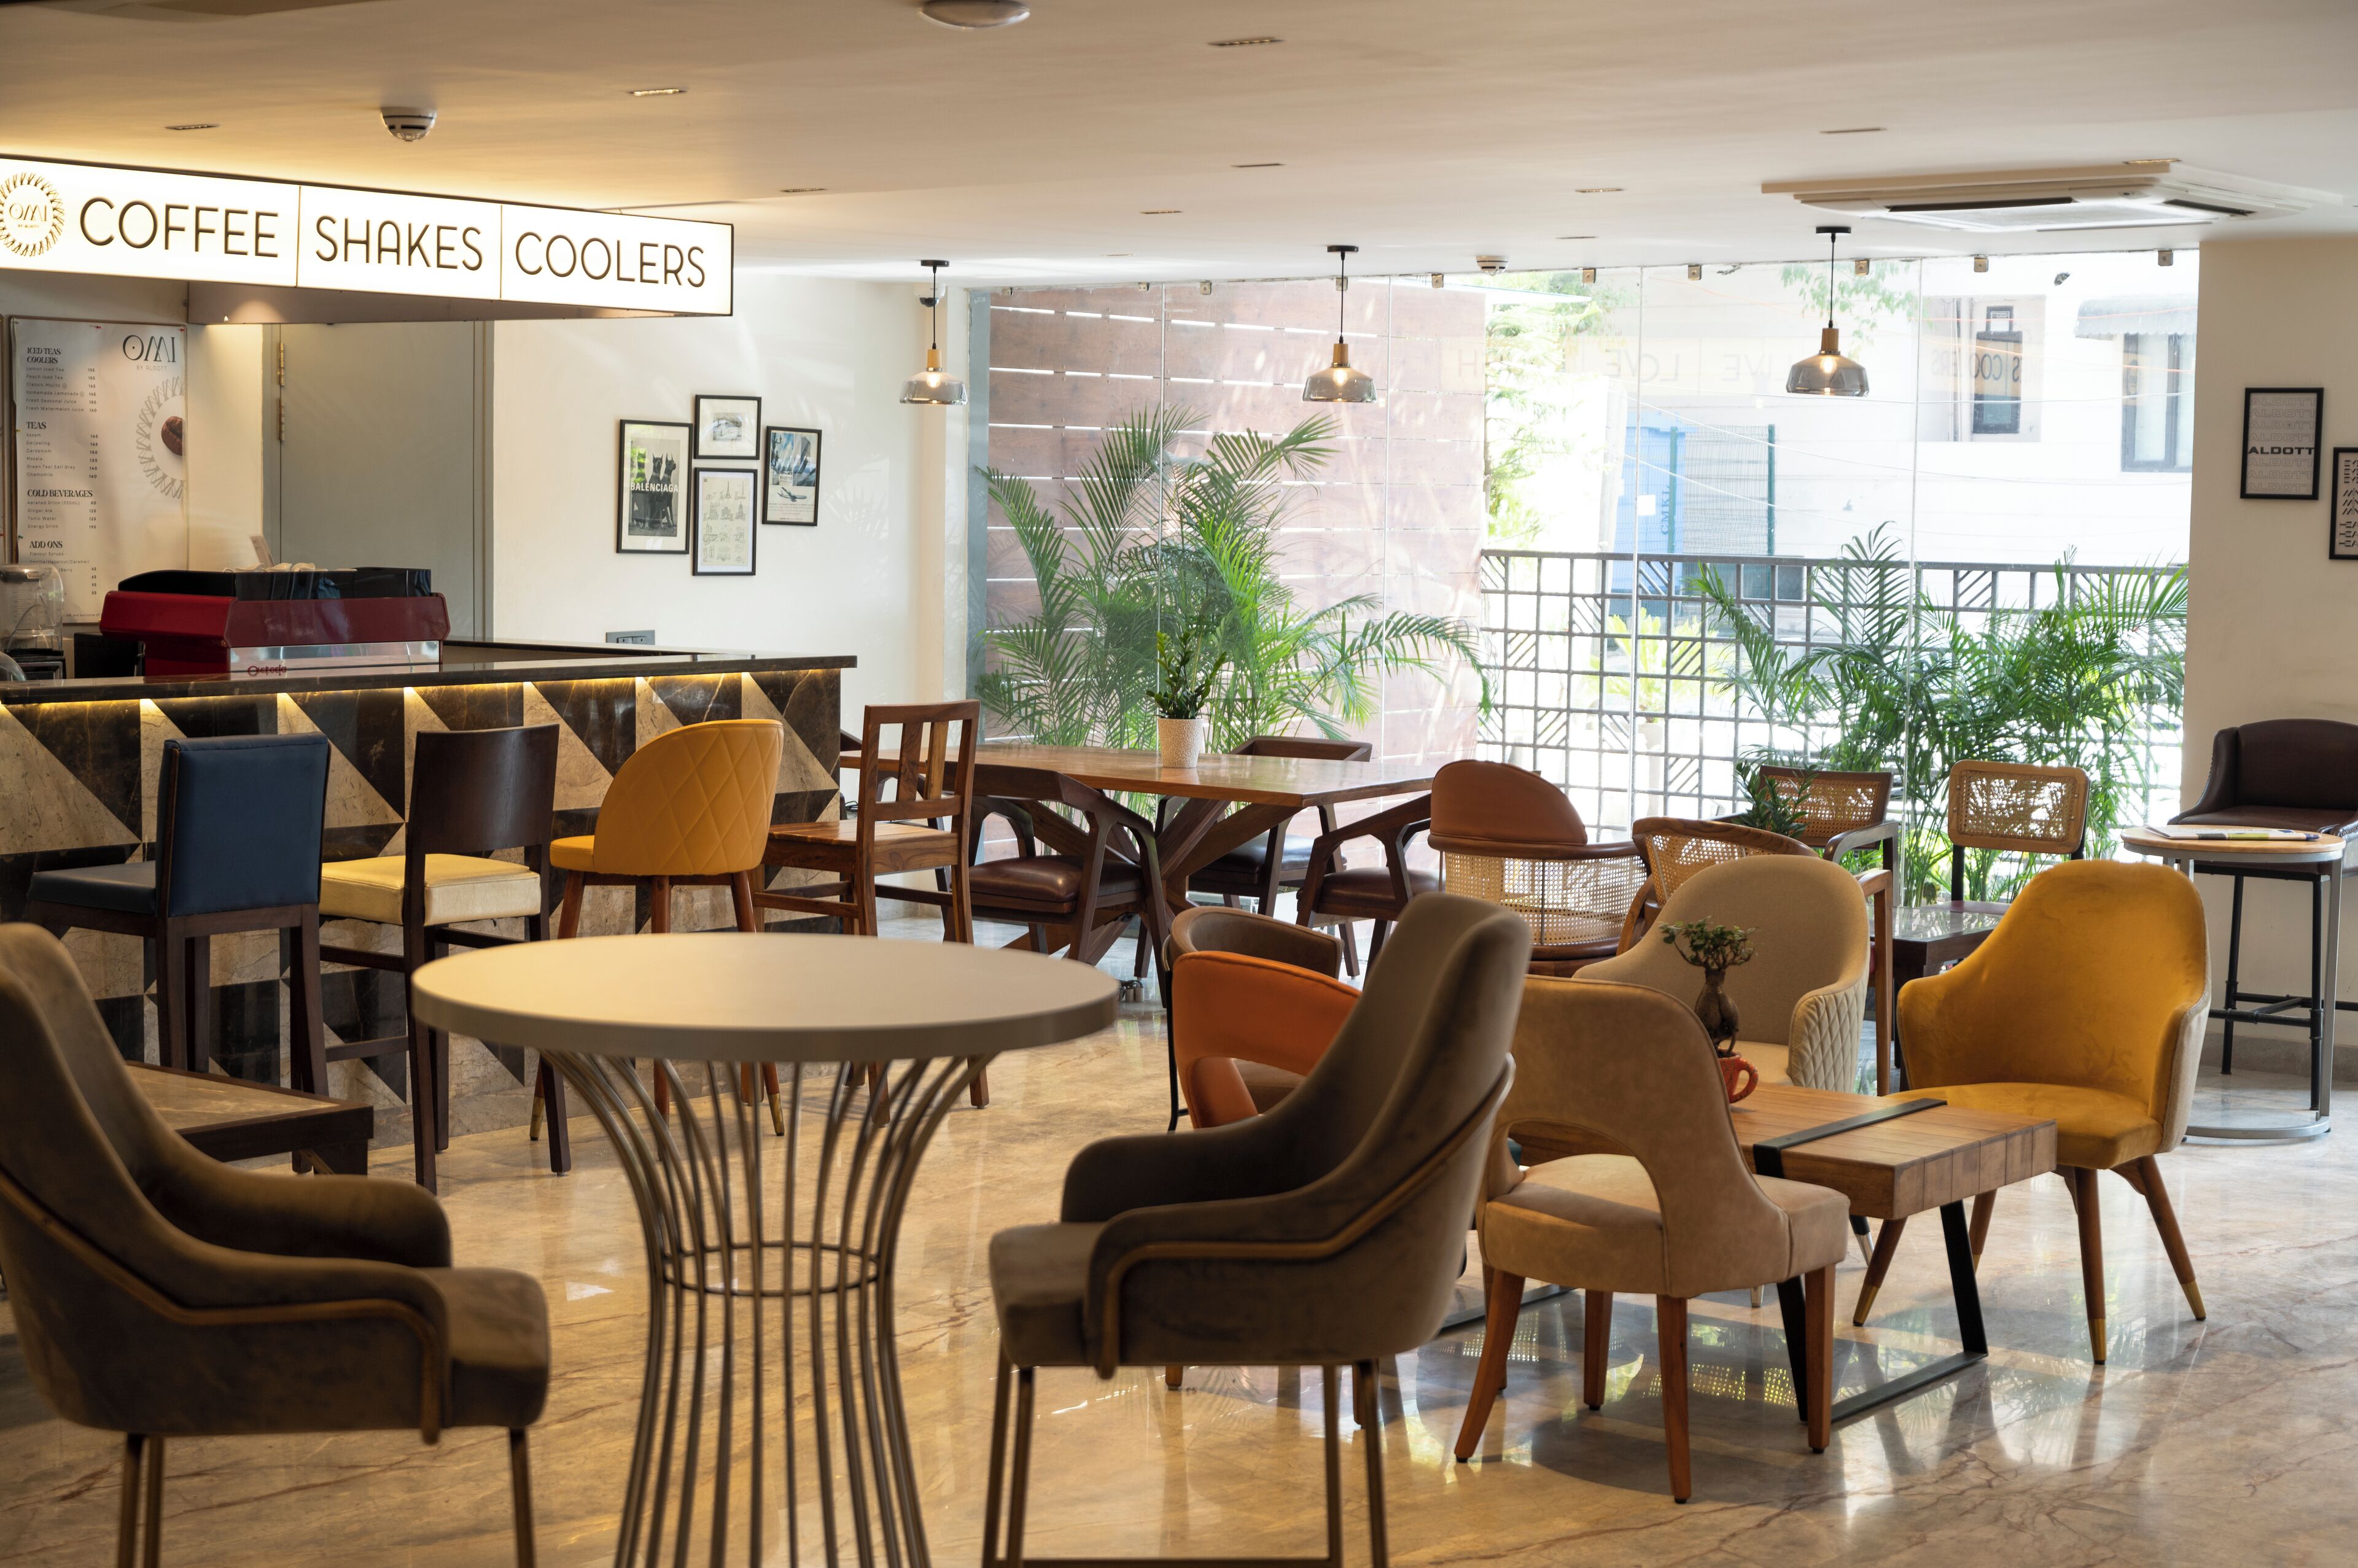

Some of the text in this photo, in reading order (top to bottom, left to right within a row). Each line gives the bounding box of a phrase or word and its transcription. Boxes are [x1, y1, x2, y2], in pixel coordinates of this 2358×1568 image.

[80, 196, 278, 258] COFFEE
[315, 215, 483, 271] SHAKES
[515, 231, 706, 288] COOLERS
[123, 335, 176, 362] OMI
[2251, 397, 2316, 406] ALDOTT
[2250, 408, 2316, 417] ALDOTT
[2250, 421, 2316, 429] ALDOTT
[2249, 433, 2315, 441] ALDOTT
[2247, 446, 2314, 455] ALDOTT
[2248, 458, 2314, 467] ALDOTT
[2247, 470, 2314, 479] ALDOTT
[631, 482, 679, 492] BALENCIAGA
[2247, 483, 2313, 492] ALDOTT
